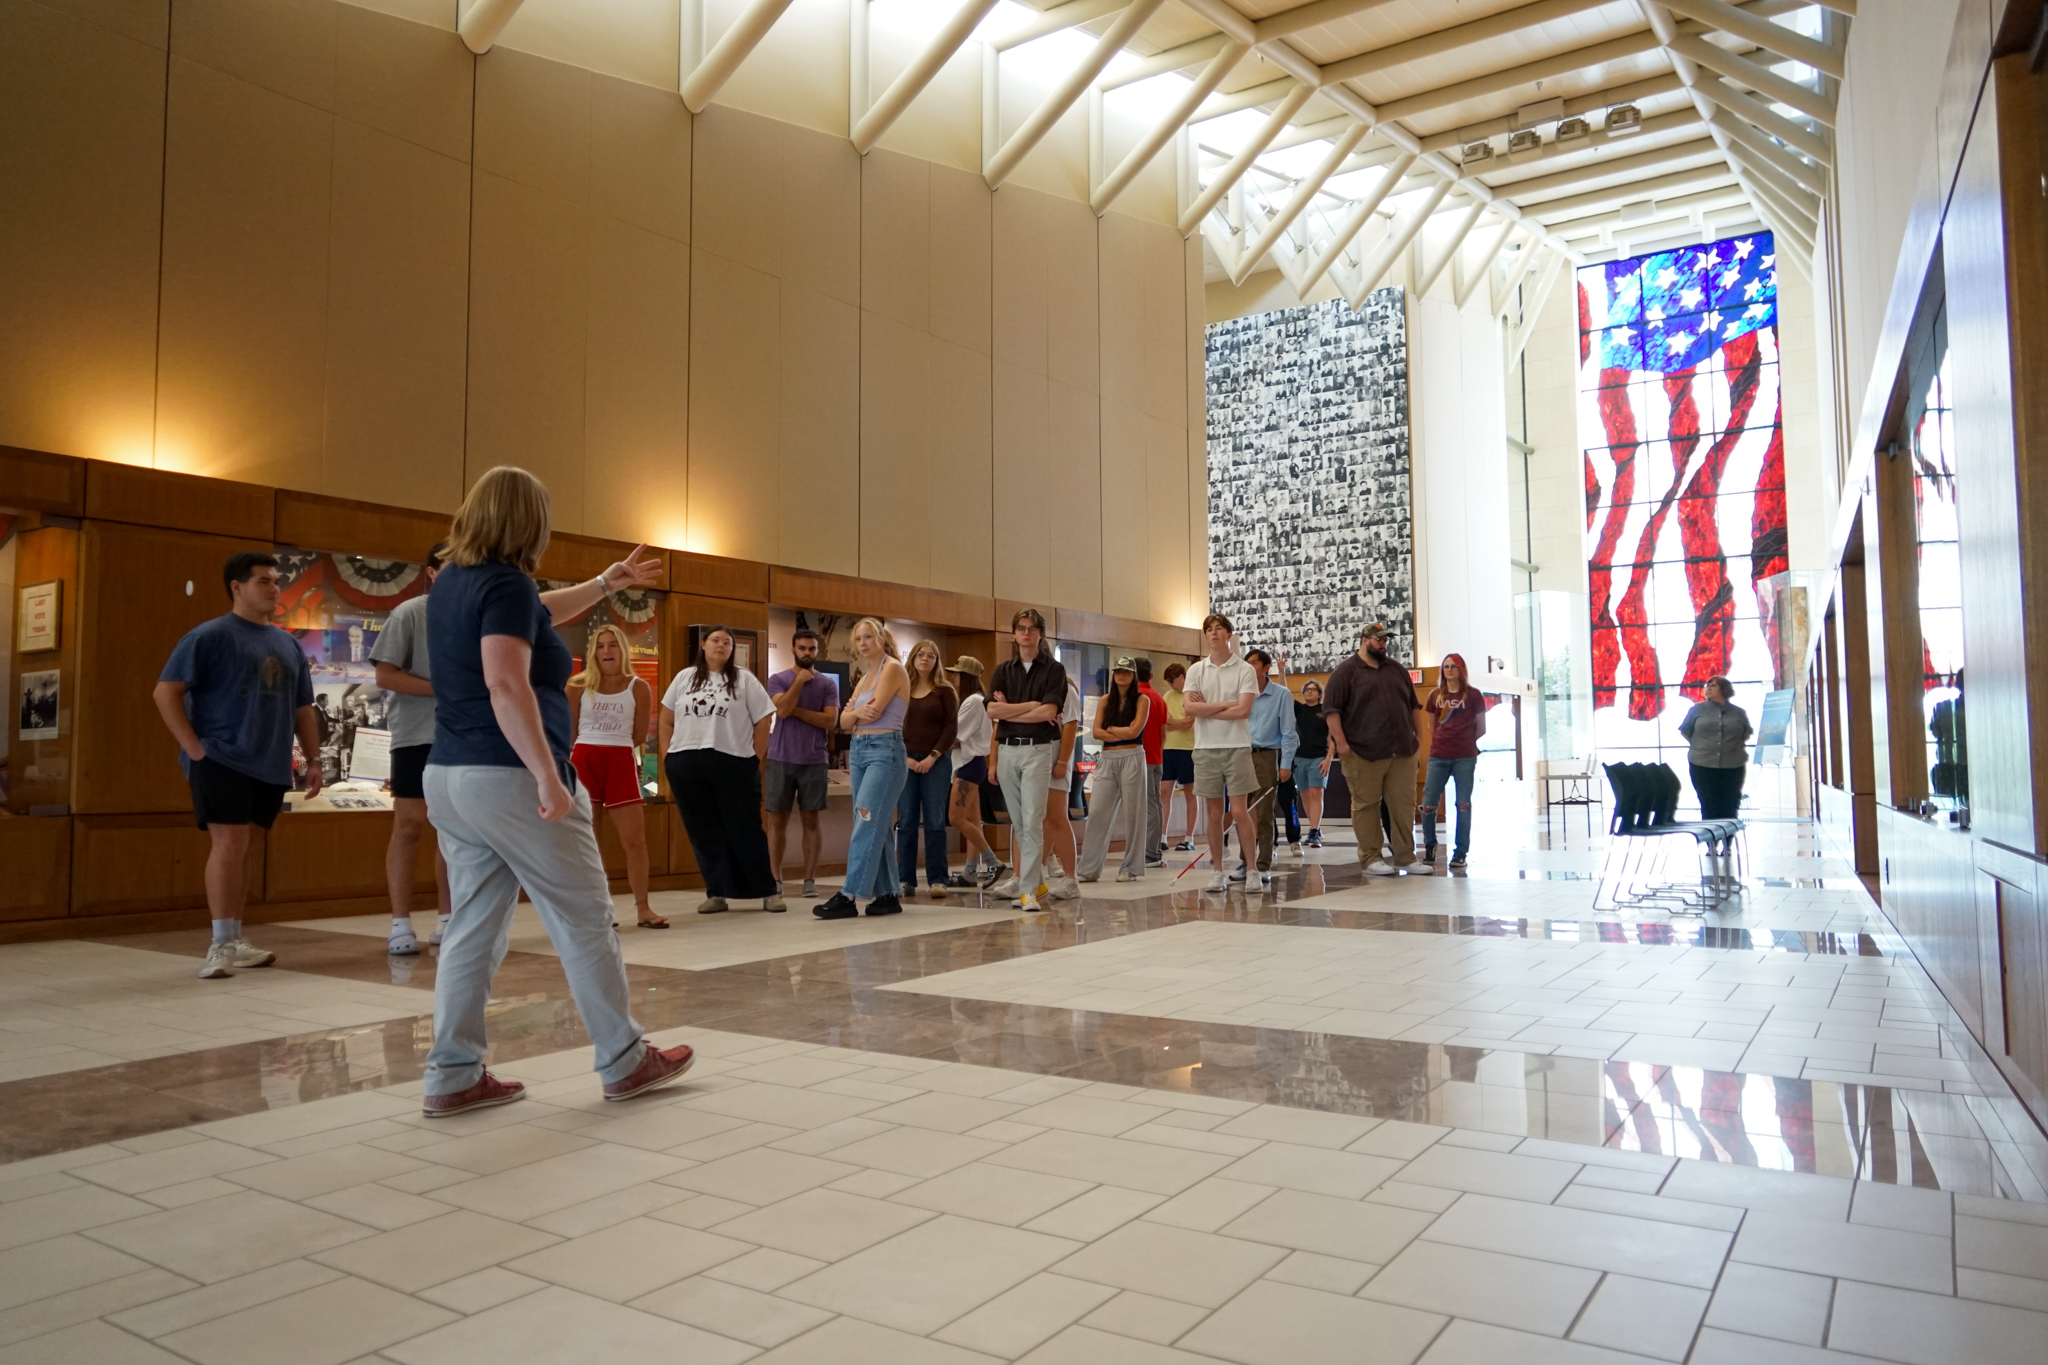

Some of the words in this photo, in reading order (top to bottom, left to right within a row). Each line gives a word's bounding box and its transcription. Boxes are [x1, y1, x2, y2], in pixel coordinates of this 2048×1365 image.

[34, 599, 46, 607] LAST
[361, 619, 384, 632] The
[592, 702, 624, 711] THETA
[1435, 699, 1466, 709] NASA
[591, 722, 622, 731] CHILD
